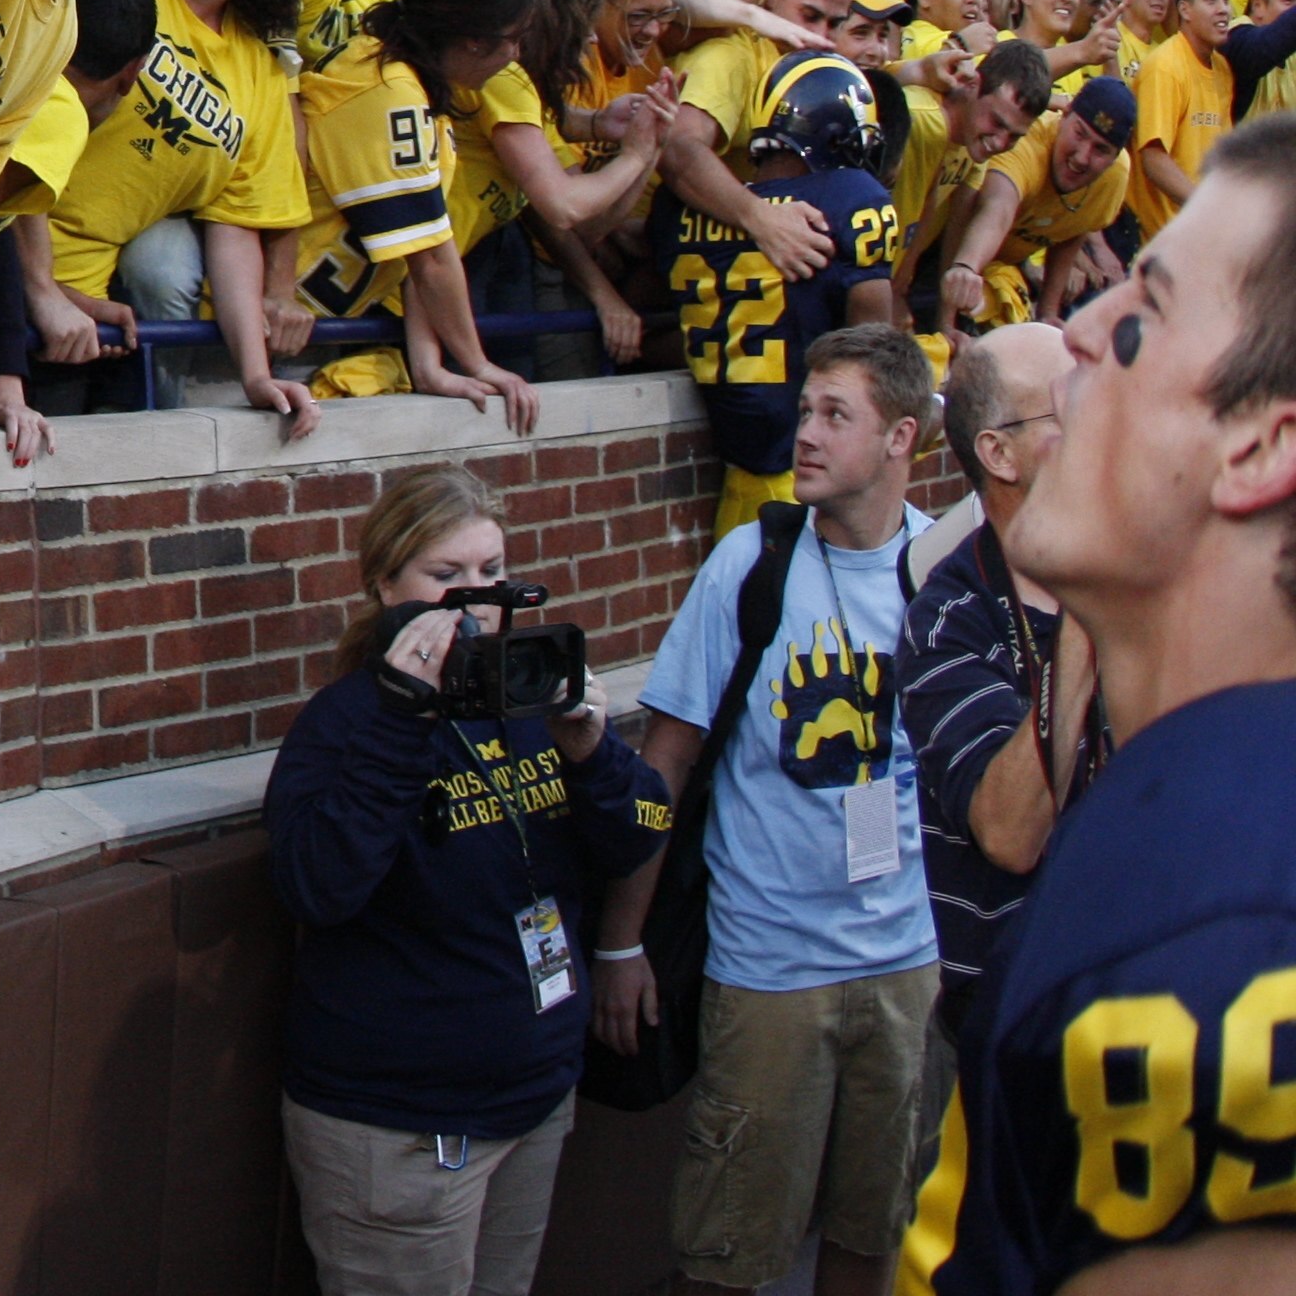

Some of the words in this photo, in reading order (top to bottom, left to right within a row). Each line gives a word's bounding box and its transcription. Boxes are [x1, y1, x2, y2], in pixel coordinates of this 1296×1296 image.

[143, 96, 192, 147] M
[851, 205, 899, 267] 22
[670, 252, 786, 384] 22
[475, 738, 507, 762] M
